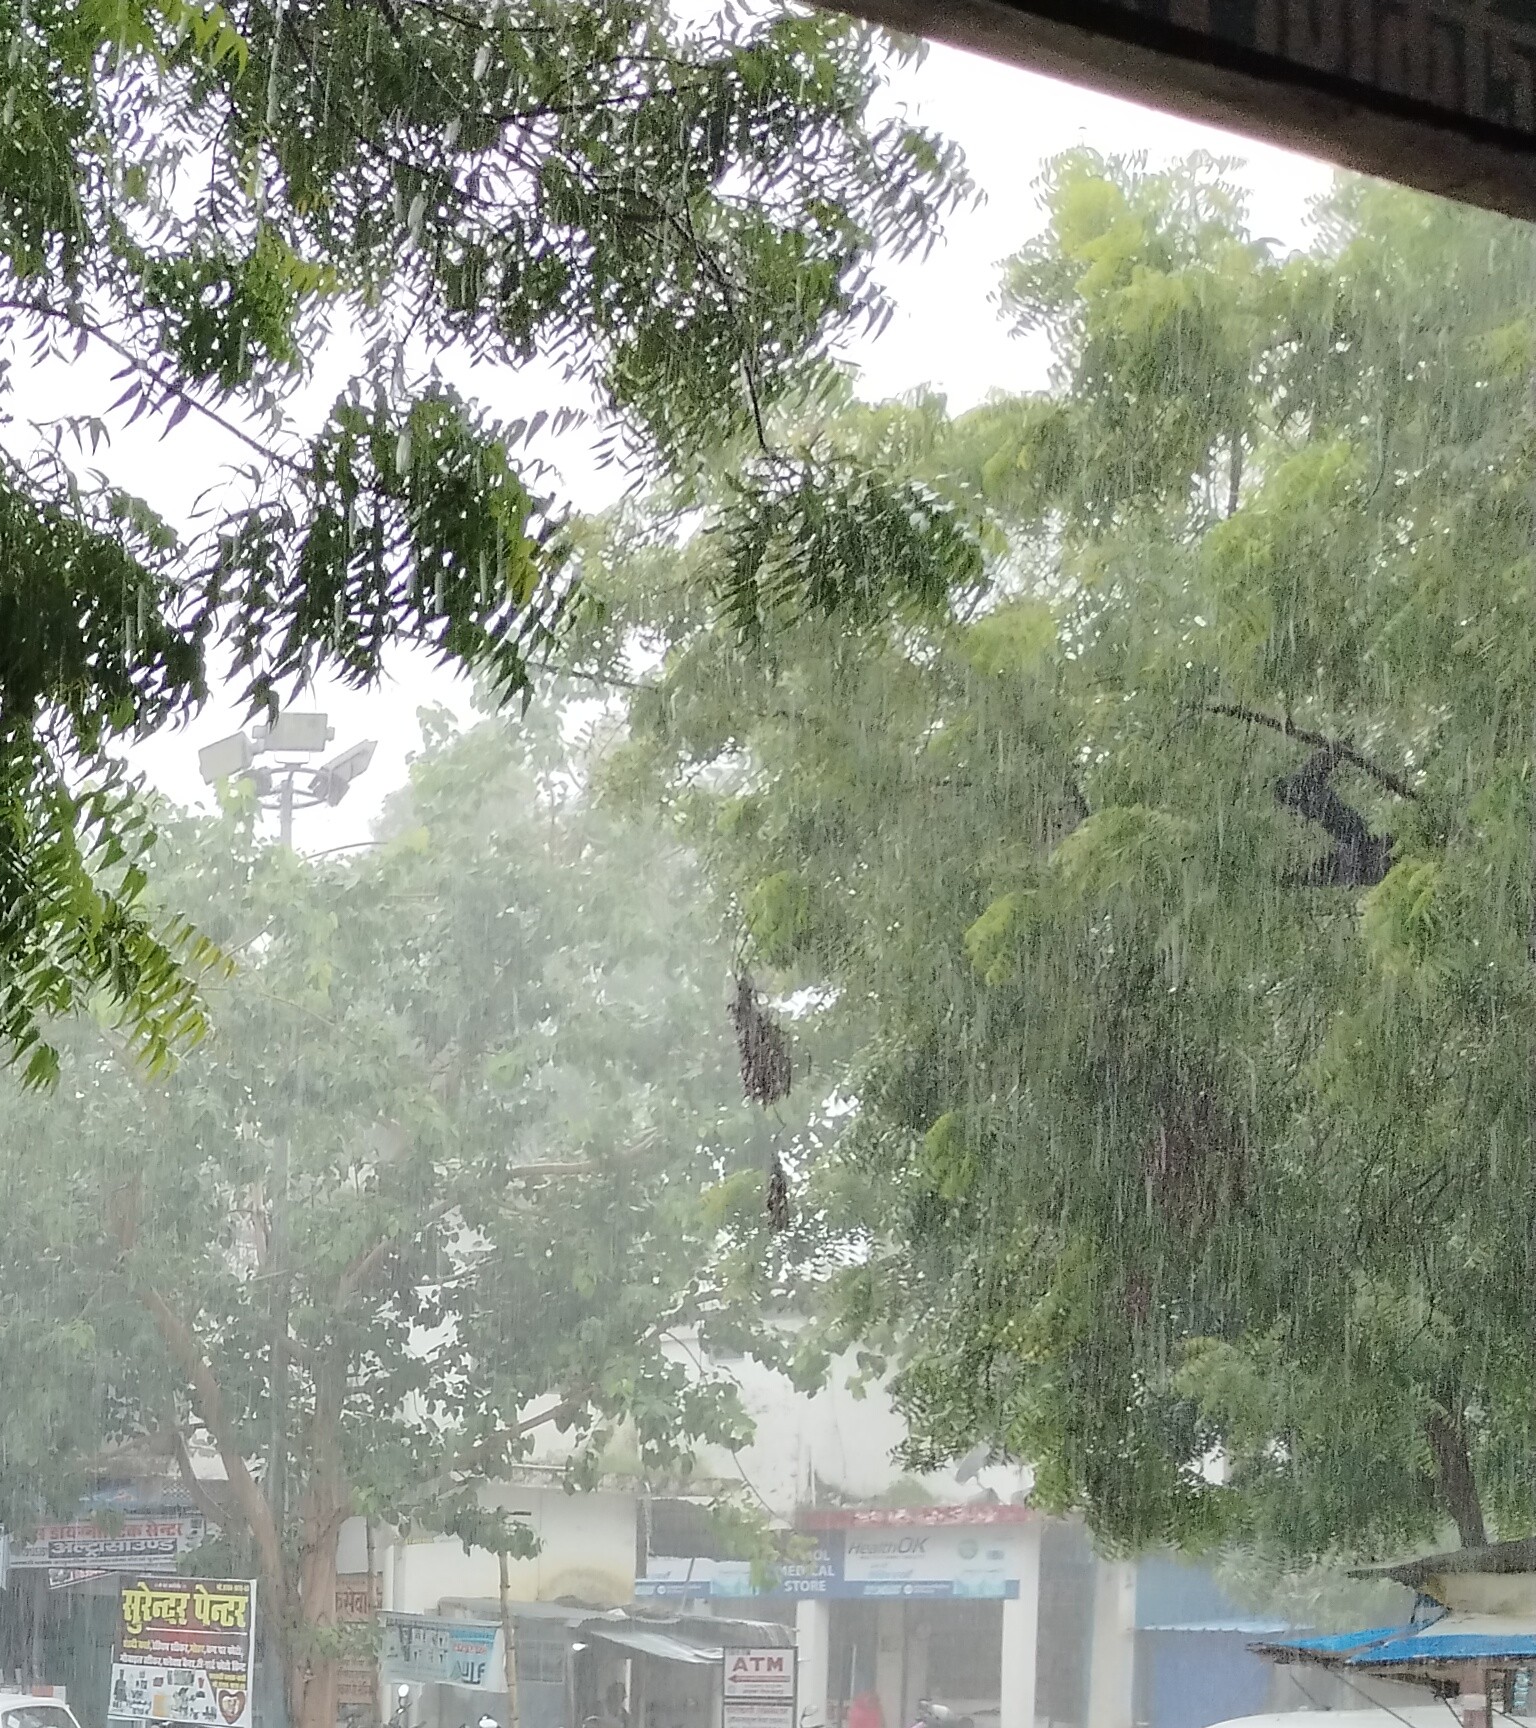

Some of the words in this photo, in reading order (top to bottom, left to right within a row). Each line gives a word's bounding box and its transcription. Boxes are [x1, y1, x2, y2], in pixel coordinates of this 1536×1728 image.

[783, 1579, 827, 1592] STORE
[193, 1584, 249, 1628] पेन्टर
[732, 1657, 784, 1672] ATM
